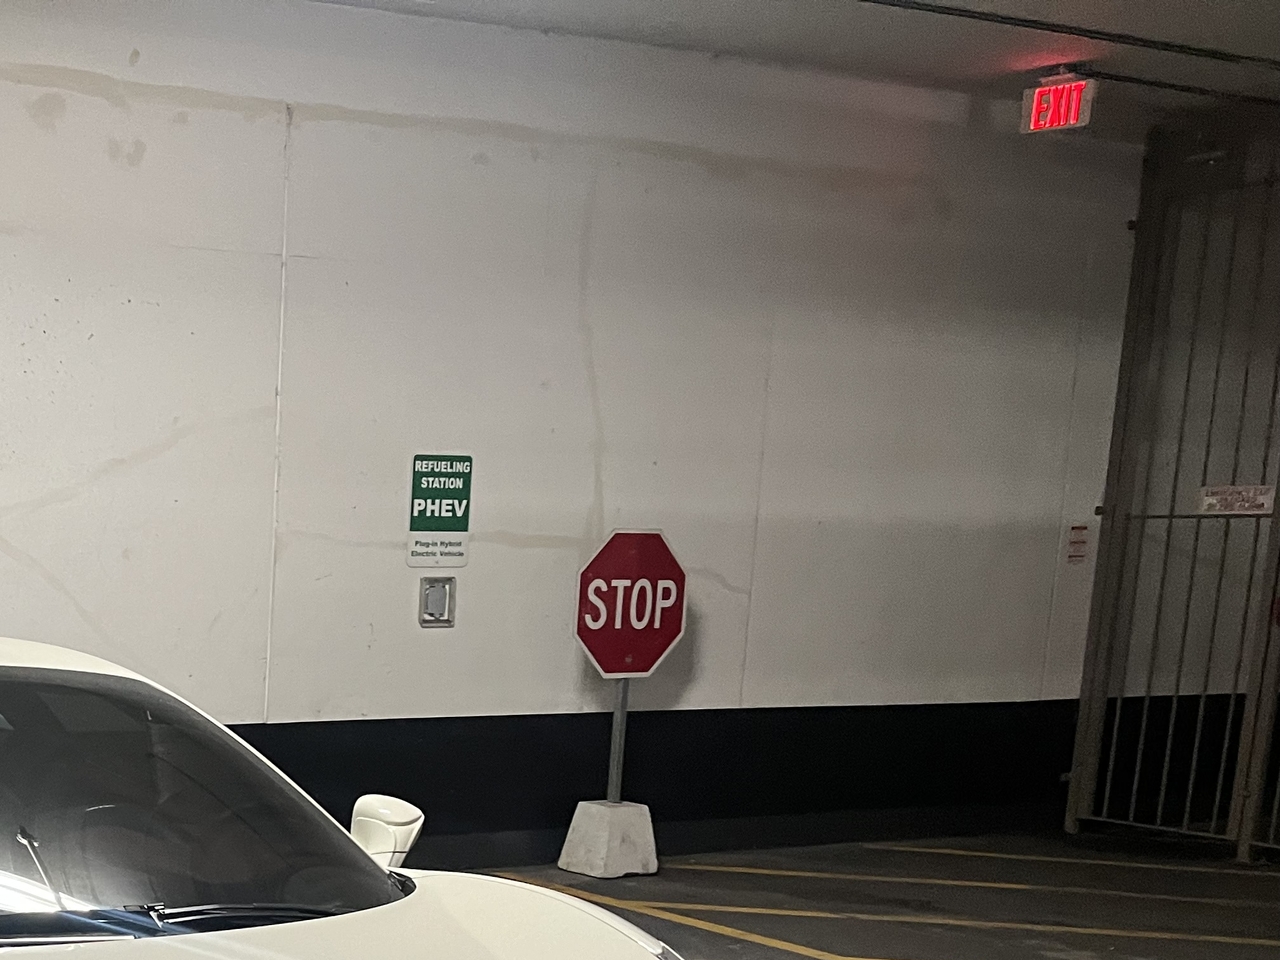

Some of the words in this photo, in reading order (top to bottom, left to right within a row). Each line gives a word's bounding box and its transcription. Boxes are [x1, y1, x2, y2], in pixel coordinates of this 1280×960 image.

[1030, 80, 1087, 130] EXIT
[415, 461, 470, 472] REFUELING
[421, 477, 463, 488] STATION
[412, 498, 468, 517] PHEV
[415, 541, 438, 549] Plug-in
[440, 541, 462, 549] Hybrid
[584, 578, 677, 630] STOP
